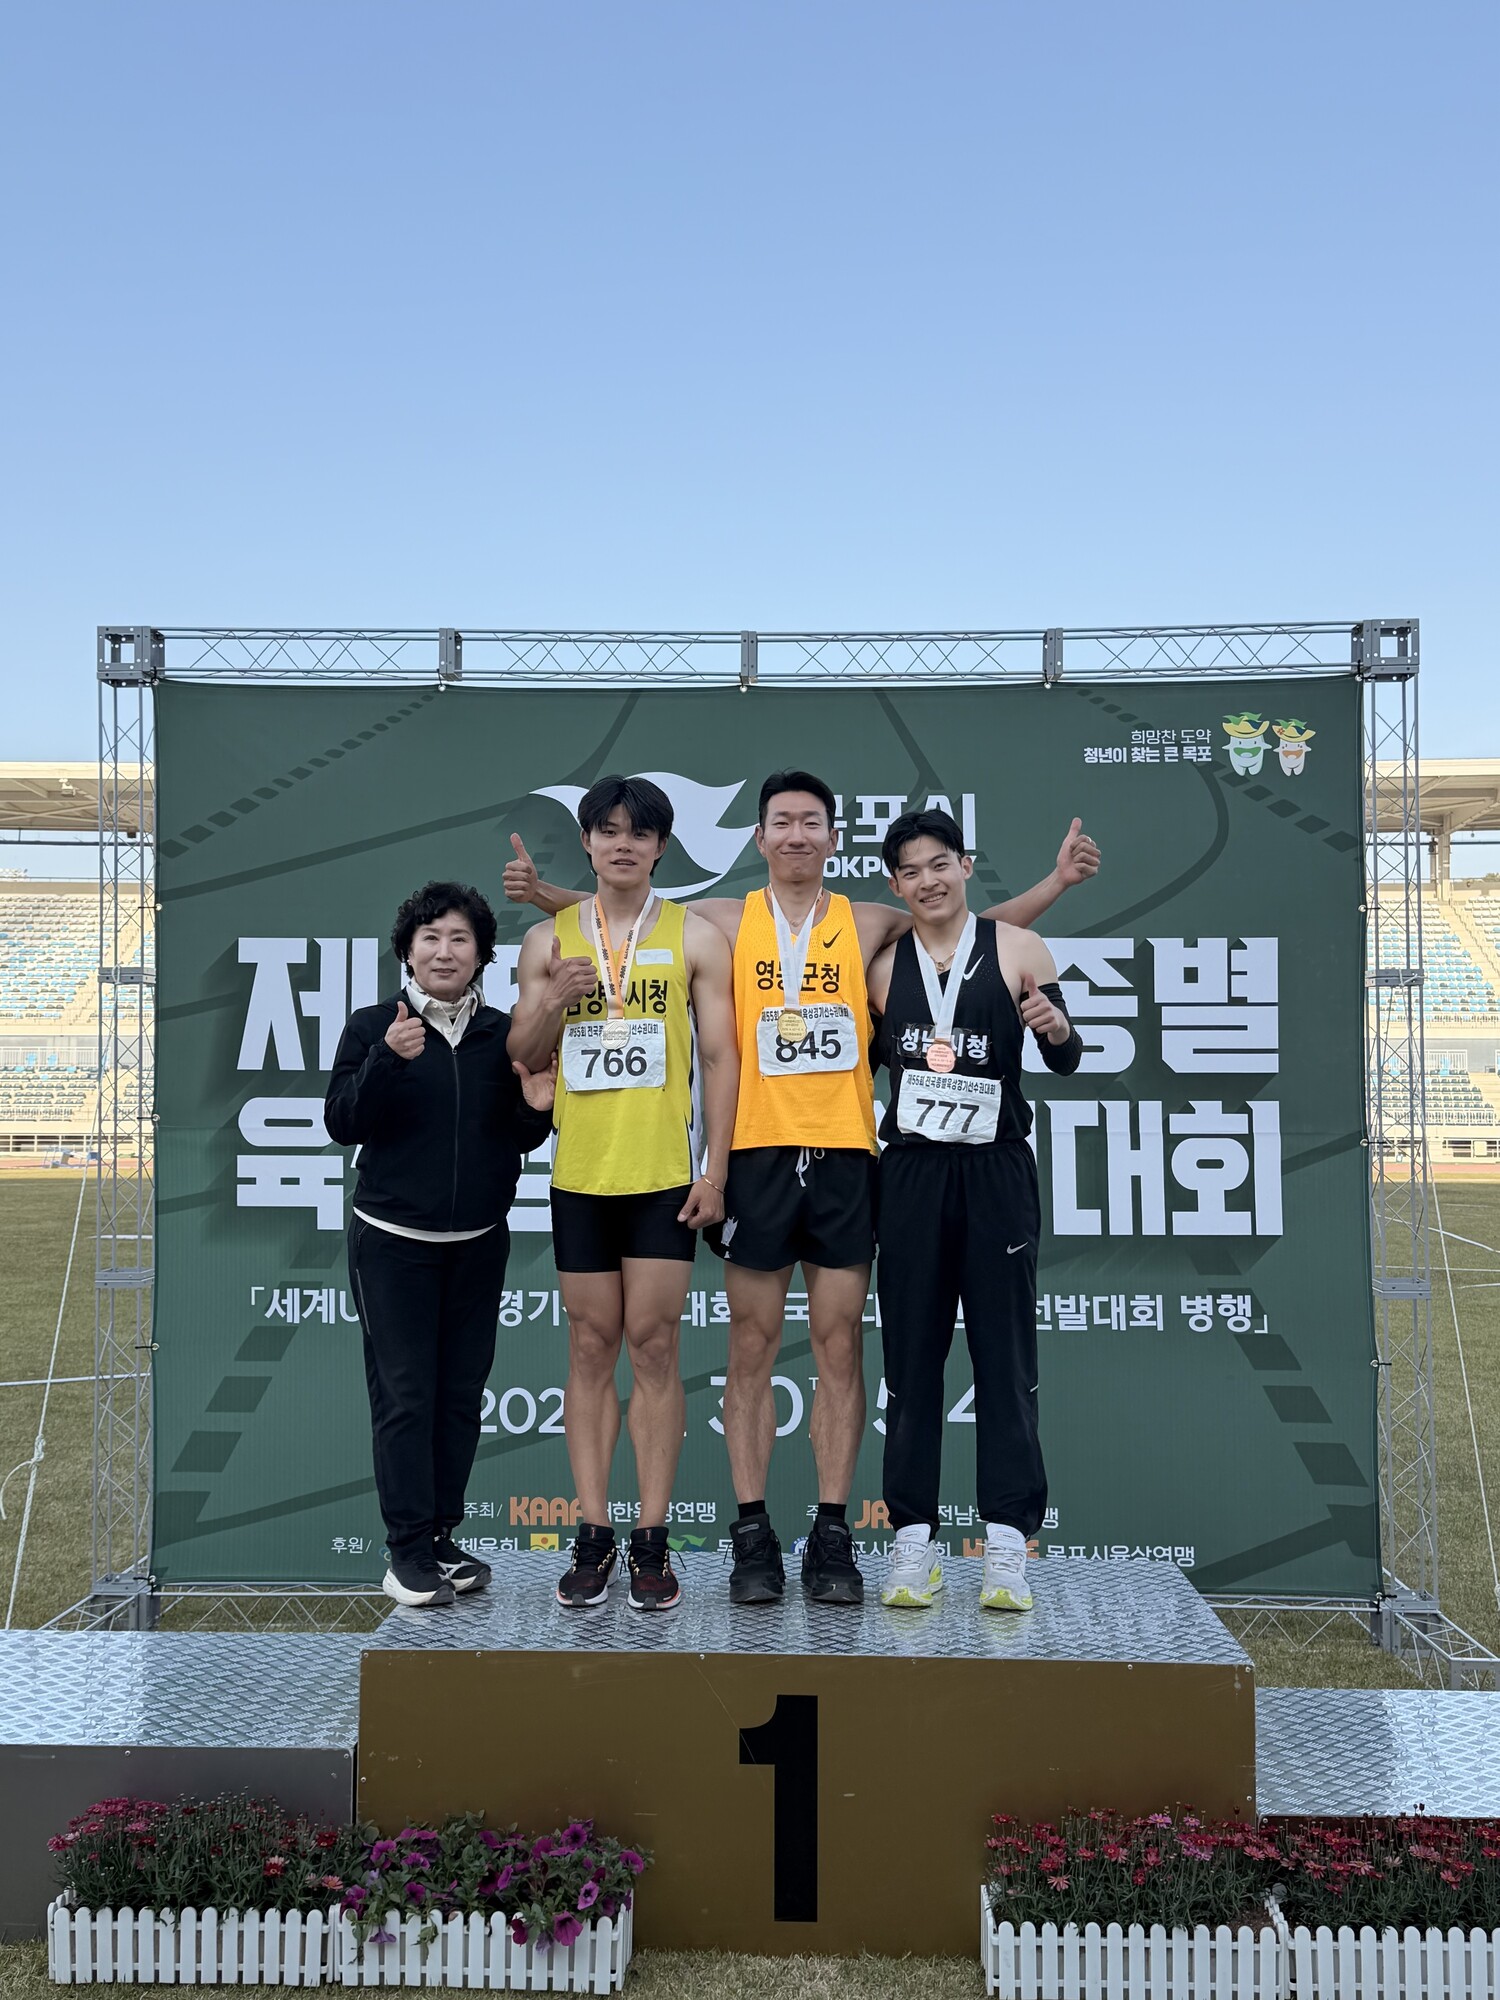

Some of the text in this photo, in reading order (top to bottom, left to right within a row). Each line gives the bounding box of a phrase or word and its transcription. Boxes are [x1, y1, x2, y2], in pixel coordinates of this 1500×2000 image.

[1131, 729, 1212, 745] 희망찬 도약
[1083, 746, 1212, 764] 청년이 찾는 큰 목포
[823, 855, 892, 879] OKP
[566, 978, 669, 1017] 양시청
[775, 1028, 842, 1063] 845
[580, 1046, 648, 1079] 766
[906, 1073, 926, 1087] 제55회
[915, 1097, 980, 1134] 777
[738, 1694, 818, 1923] 1
